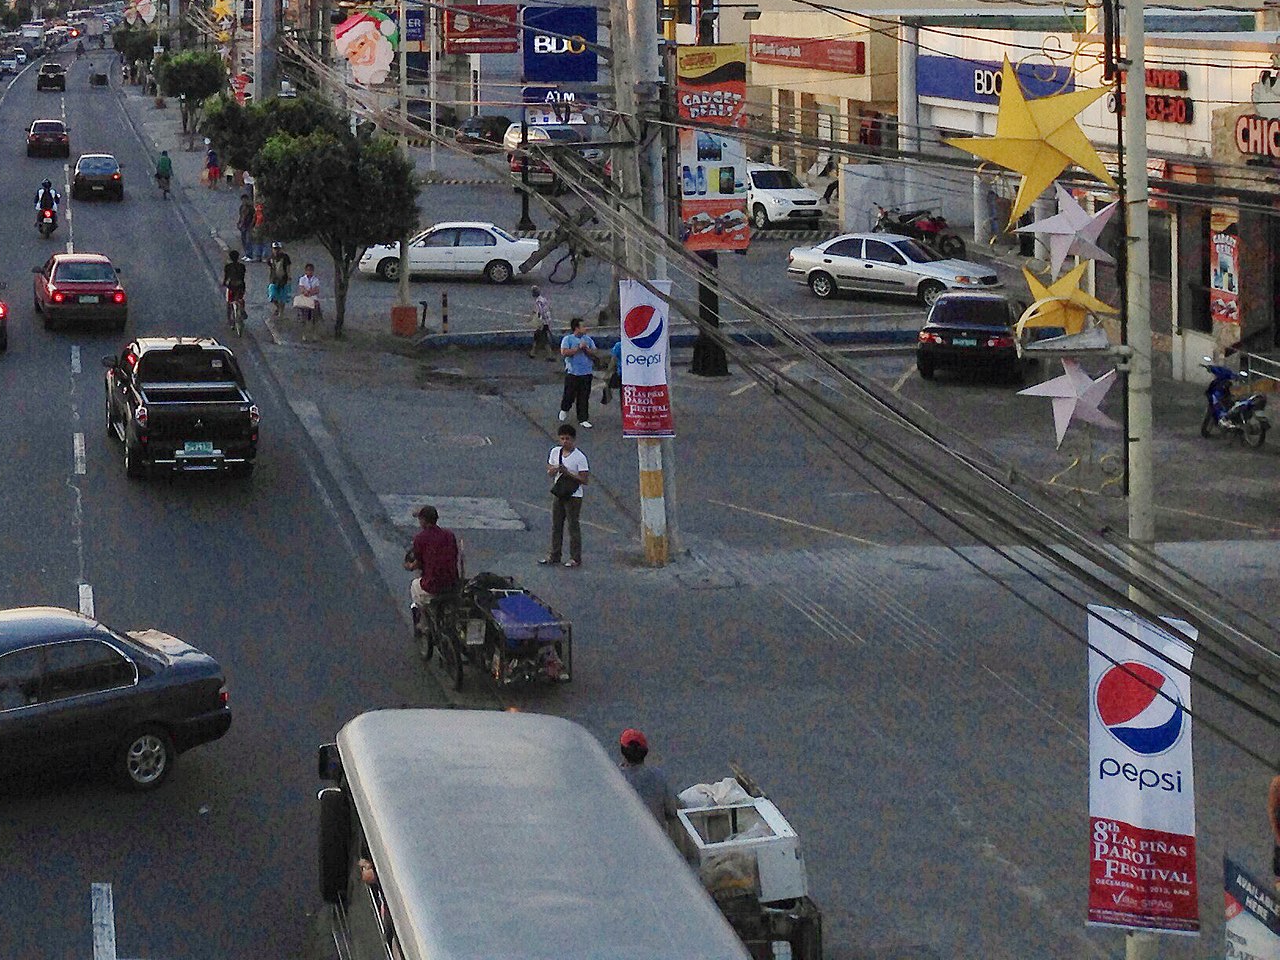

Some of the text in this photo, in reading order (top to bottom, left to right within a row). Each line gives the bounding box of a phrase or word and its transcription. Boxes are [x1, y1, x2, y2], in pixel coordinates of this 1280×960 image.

[534, 34, 587, 54] BDO
[974, 69, 1003, 97] BDO
[545, 90, 576, 104] ATM
[681, 90, 742, 106] GADGET
[626, 353, 661, 368] pepsi
[1100, 757, 1182, 793] pepsi
[1093, 820, 1120, 842] 8th
[1093, 841, 1157, 866] PAROL
[1112, 833, 1188, 858] LAS PIÑAS
[1095, 877, 1134, 889] DECEMBER
[1104, 859, 1193, 885] FESTIVAL
